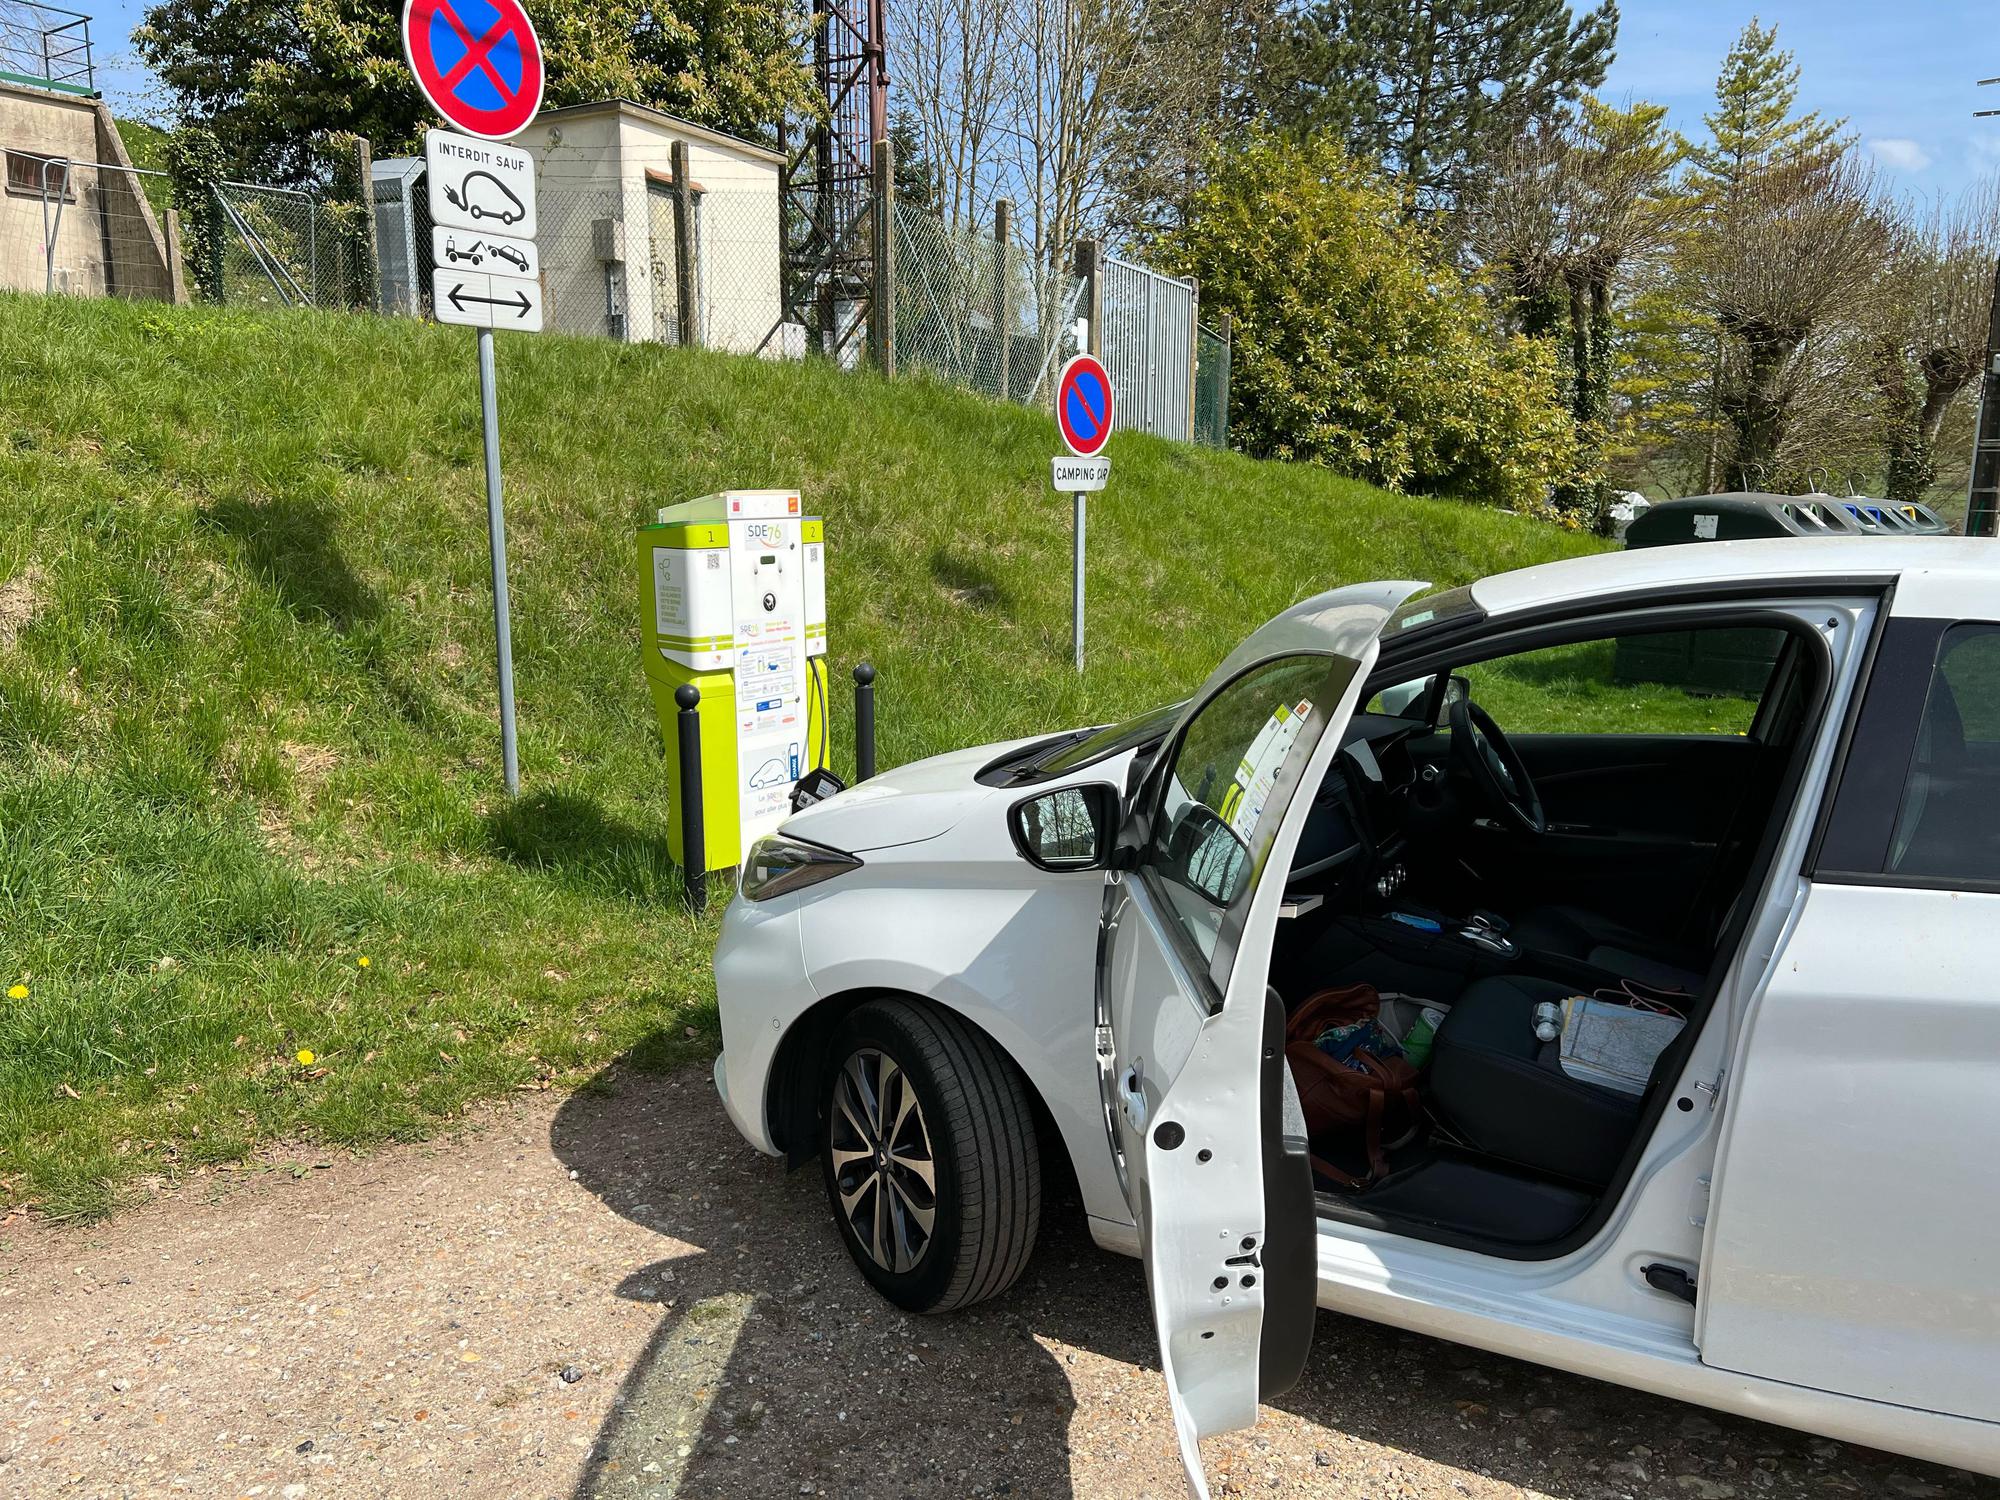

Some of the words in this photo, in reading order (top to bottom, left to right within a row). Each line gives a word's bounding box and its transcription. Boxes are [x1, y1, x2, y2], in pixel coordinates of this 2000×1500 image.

[439, 142, 490, 164] INTERDIT
[496, 155, 525, 171] SAUF
[1056, 467, 1095, 480] CAMPING
[1097, 467, 1108, 480] CAR
[708, 530, 714, 542] 1
[747, 524, 782, 542] SDE76
[810, 526, 816, 538] 2
